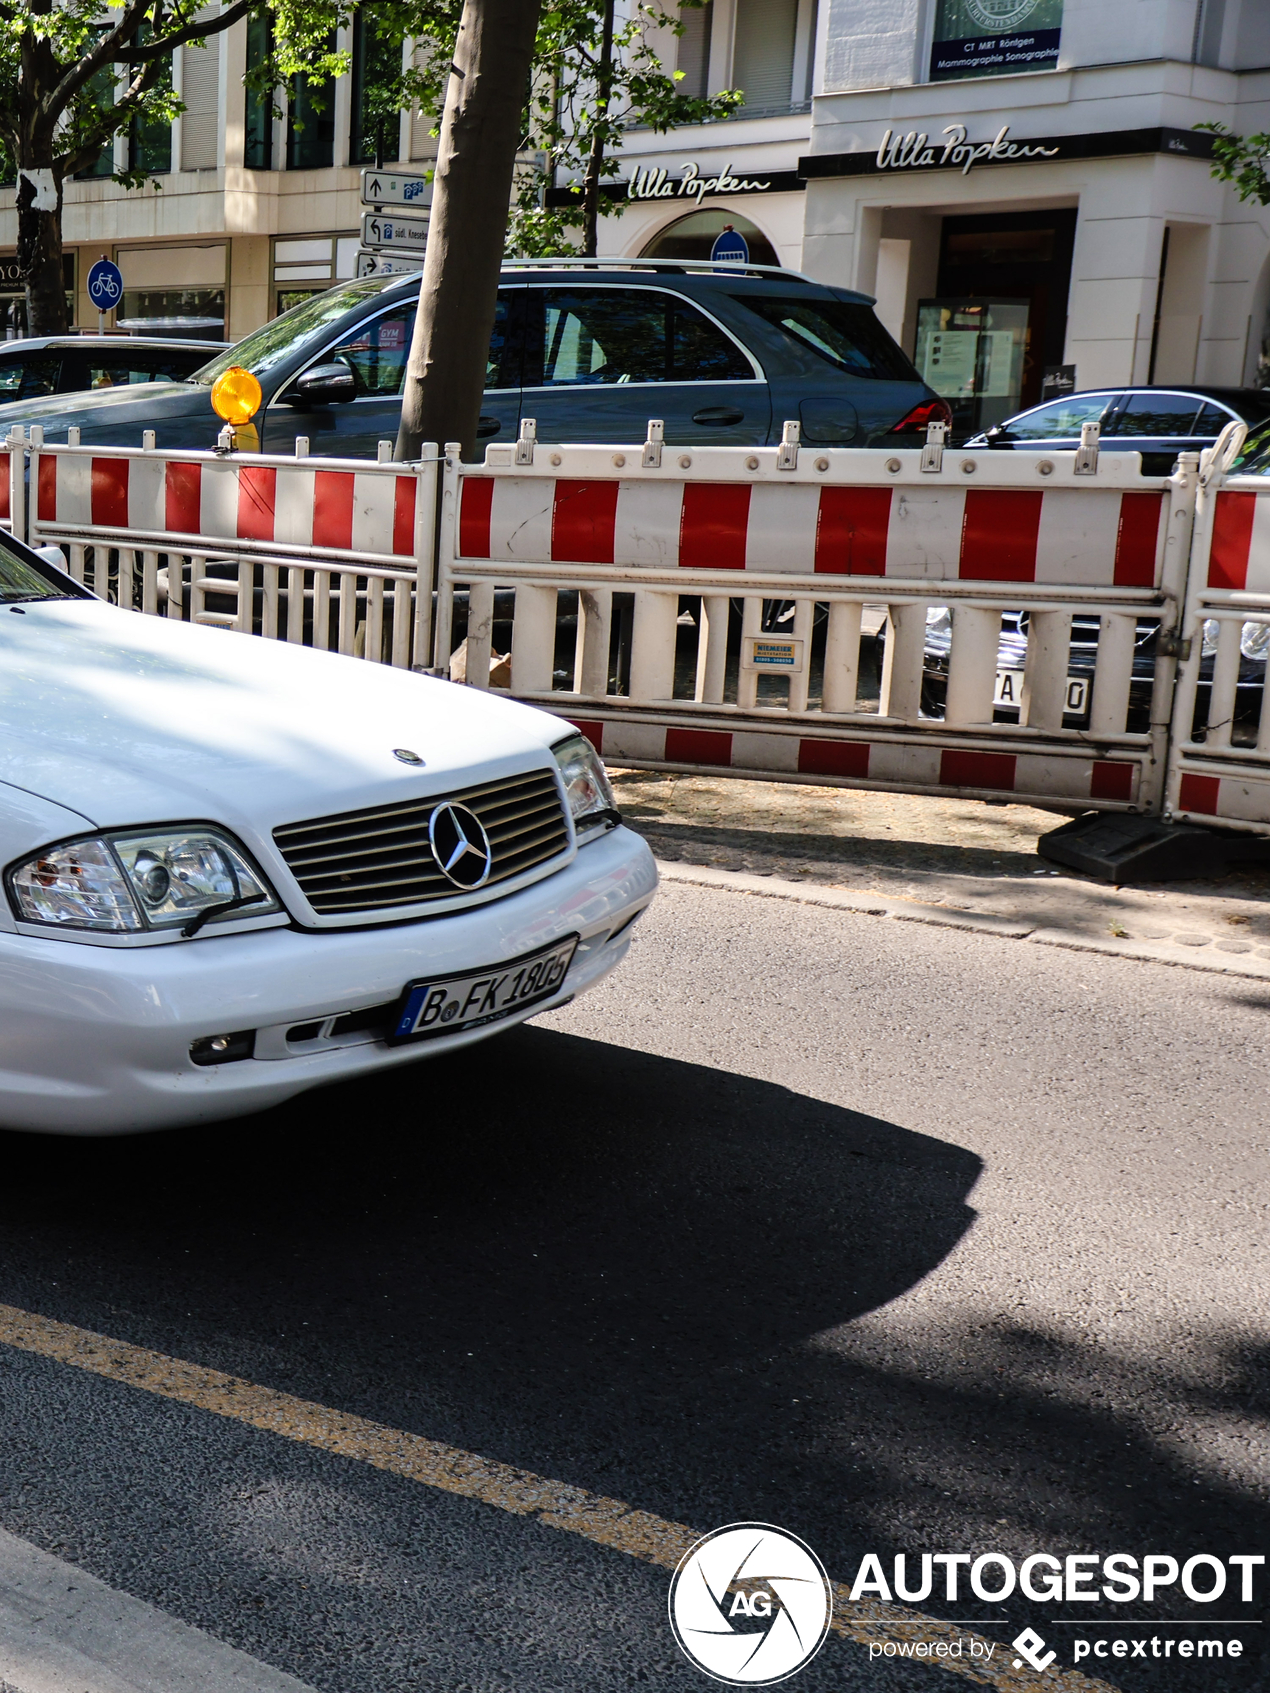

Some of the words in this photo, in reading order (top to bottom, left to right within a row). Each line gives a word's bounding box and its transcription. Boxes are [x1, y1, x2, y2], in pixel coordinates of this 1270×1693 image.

[964, 43, 976, 52] CT
[978, 40, 996, 51] MRT
[999, 37, 1035, 49] Röntgen
[937, 54, 1004, 69] Mammographie
[1005, 48, 1060, 61] Sonographie
[876, 128, 935, 169] Ulla
[940, 123, 1060, 175] Popken
[627, 165, 673, 200] Ulla
[677, 161, 771, 205] Popken
[395, 228, 406, 239] südl.
[381, 329, 399, 337] GYM
[417, 989, 448, 1028] B
[459, 973, 509, 1019] FK
